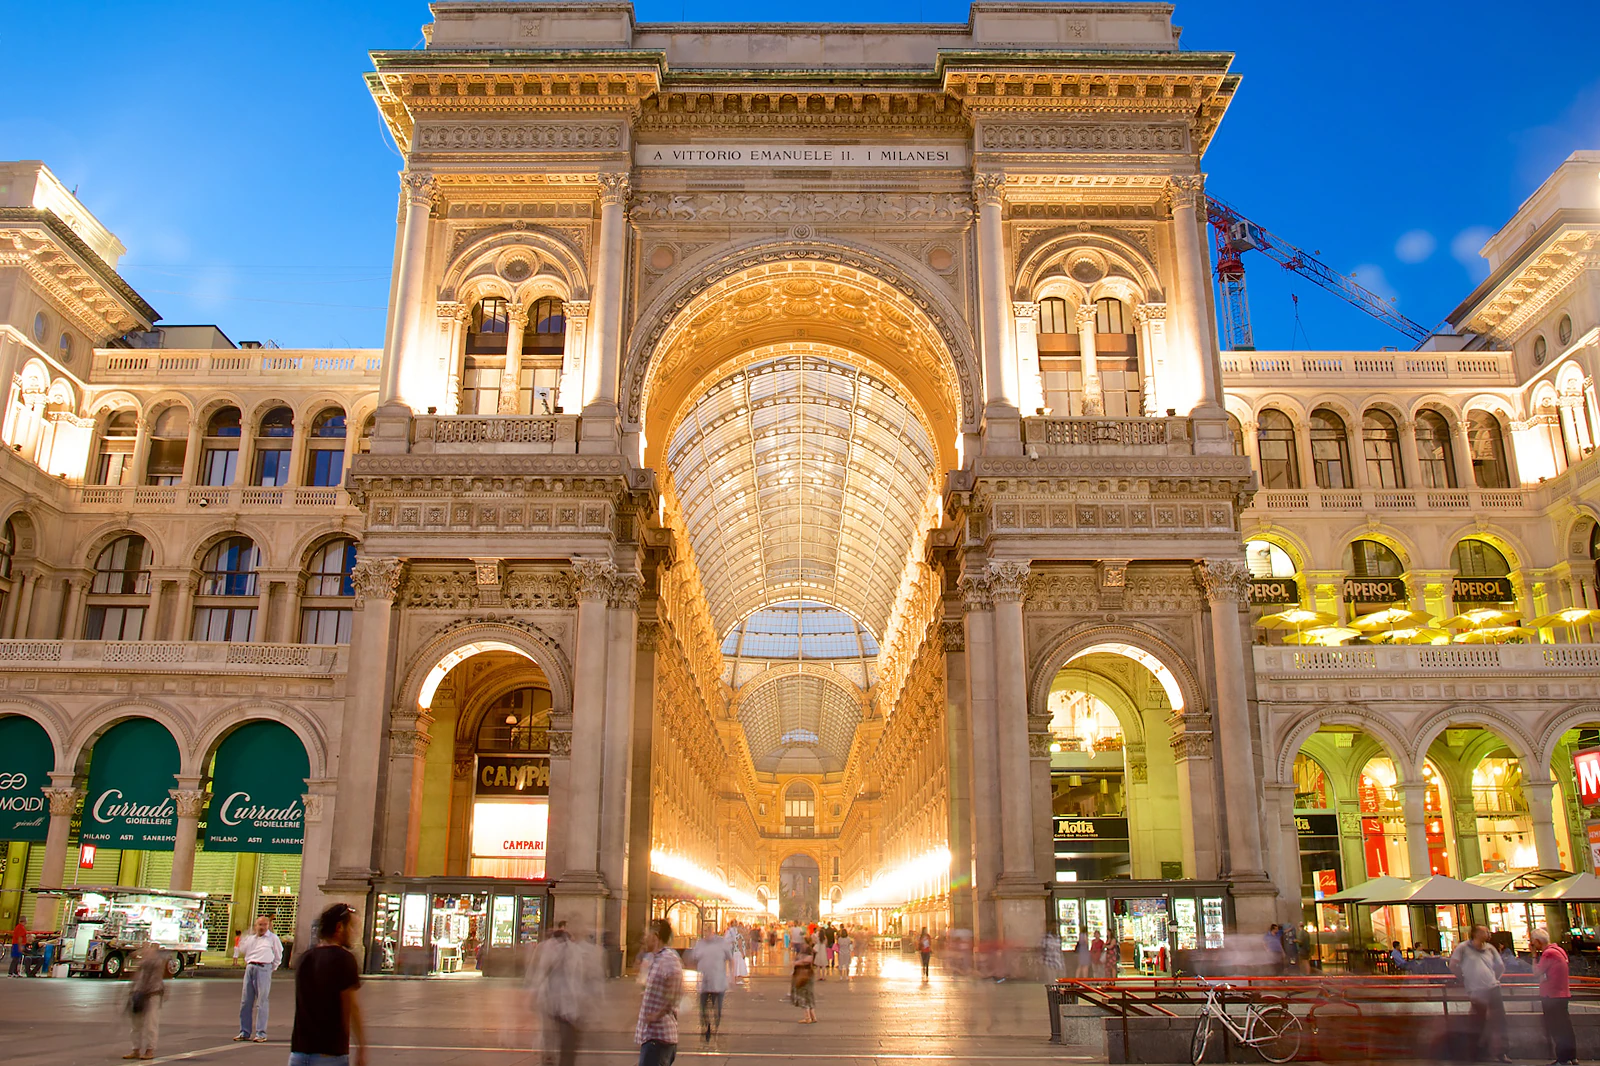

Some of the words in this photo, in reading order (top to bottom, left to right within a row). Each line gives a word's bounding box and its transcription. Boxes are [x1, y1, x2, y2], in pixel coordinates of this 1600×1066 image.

[653, 151, 663, 160] A
[673, 150, 742, 161] VITTORIO
[750, 150, 833, 161] EMANUELE
[841, 150, 855, 161] II.
[867, 150, 872, 161] I
[880, 150, 950, 161] MILANESI
[1247, 583, 1290, 598] PEROL
[1344, 580, 1397, 597] APEROL
[1453, 580, 1505, 596] APEROL
[482, 765, 550, 787] CAMPA
[0, 797, 45, 811] MOLDI
[93, 789, 175, 824] Currado
[220, 792, 303, 826] Currado
[125, 817, 173, 826] GIOIELLERIE
[253, 821, 301, 829] GIOIELLERIE
[1058, 820, 1094, 833] Motta
[83, 833, 111, 841] MILANO
[142, 834, 177, 842] SANREMO
[210, 835, 239, 843] MILANO
[247, 836, 263, 844] ASTI
[271, 837, 305, 845] SANREMO
[503, 840, 544, 850] CAMPARI
